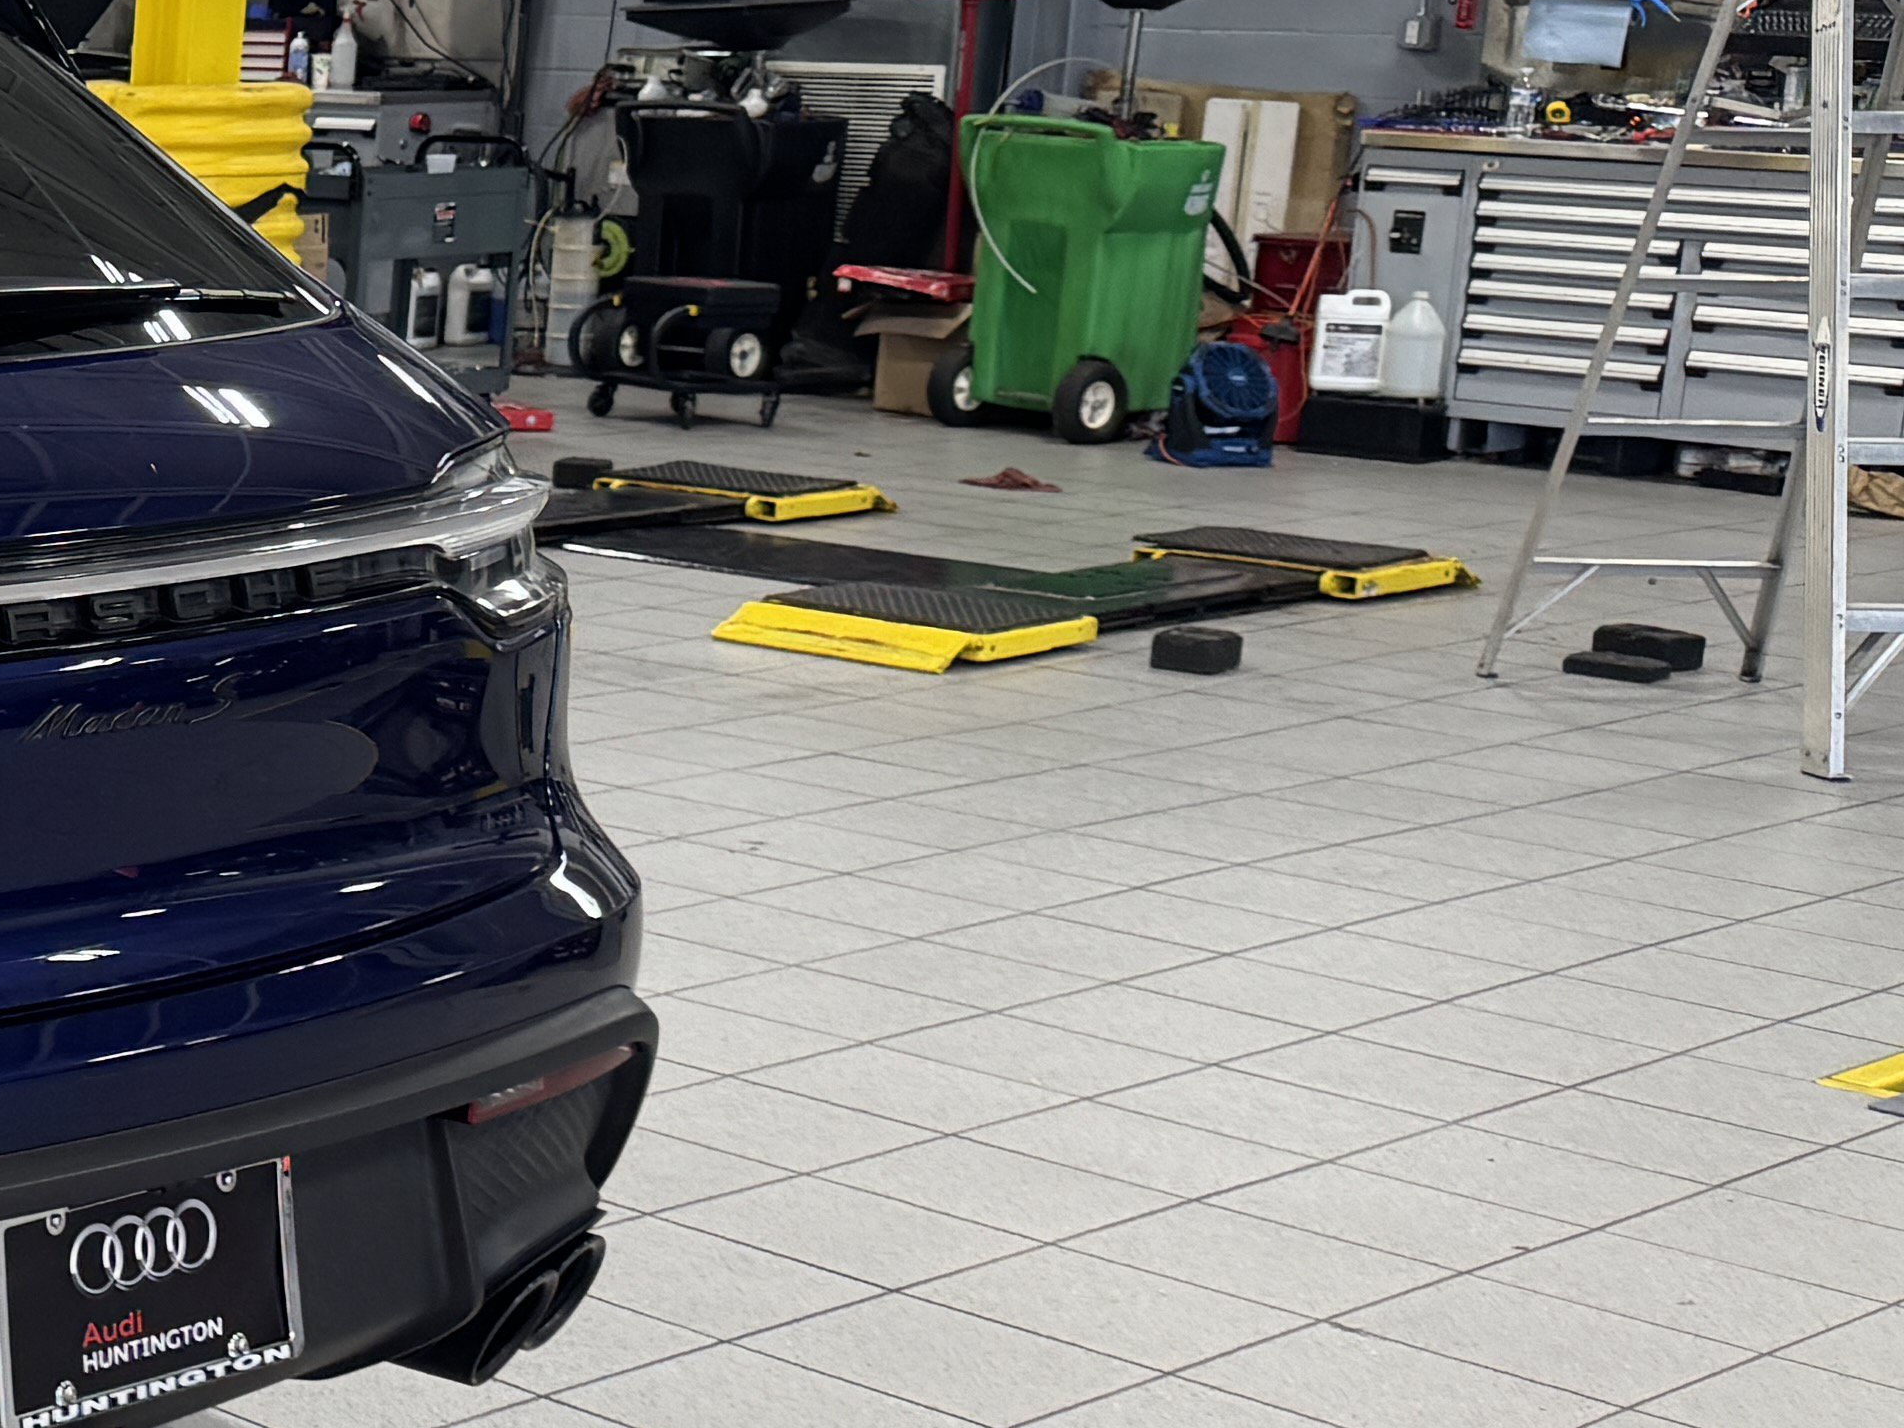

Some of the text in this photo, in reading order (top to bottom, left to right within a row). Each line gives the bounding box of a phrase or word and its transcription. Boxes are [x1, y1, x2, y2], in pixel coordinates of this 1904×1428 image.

[14, 702, 187, 744] Macan
[81, 1309, 144, 1348] Audi
[81, 1315, 224, 1374] HUNTINGTON
